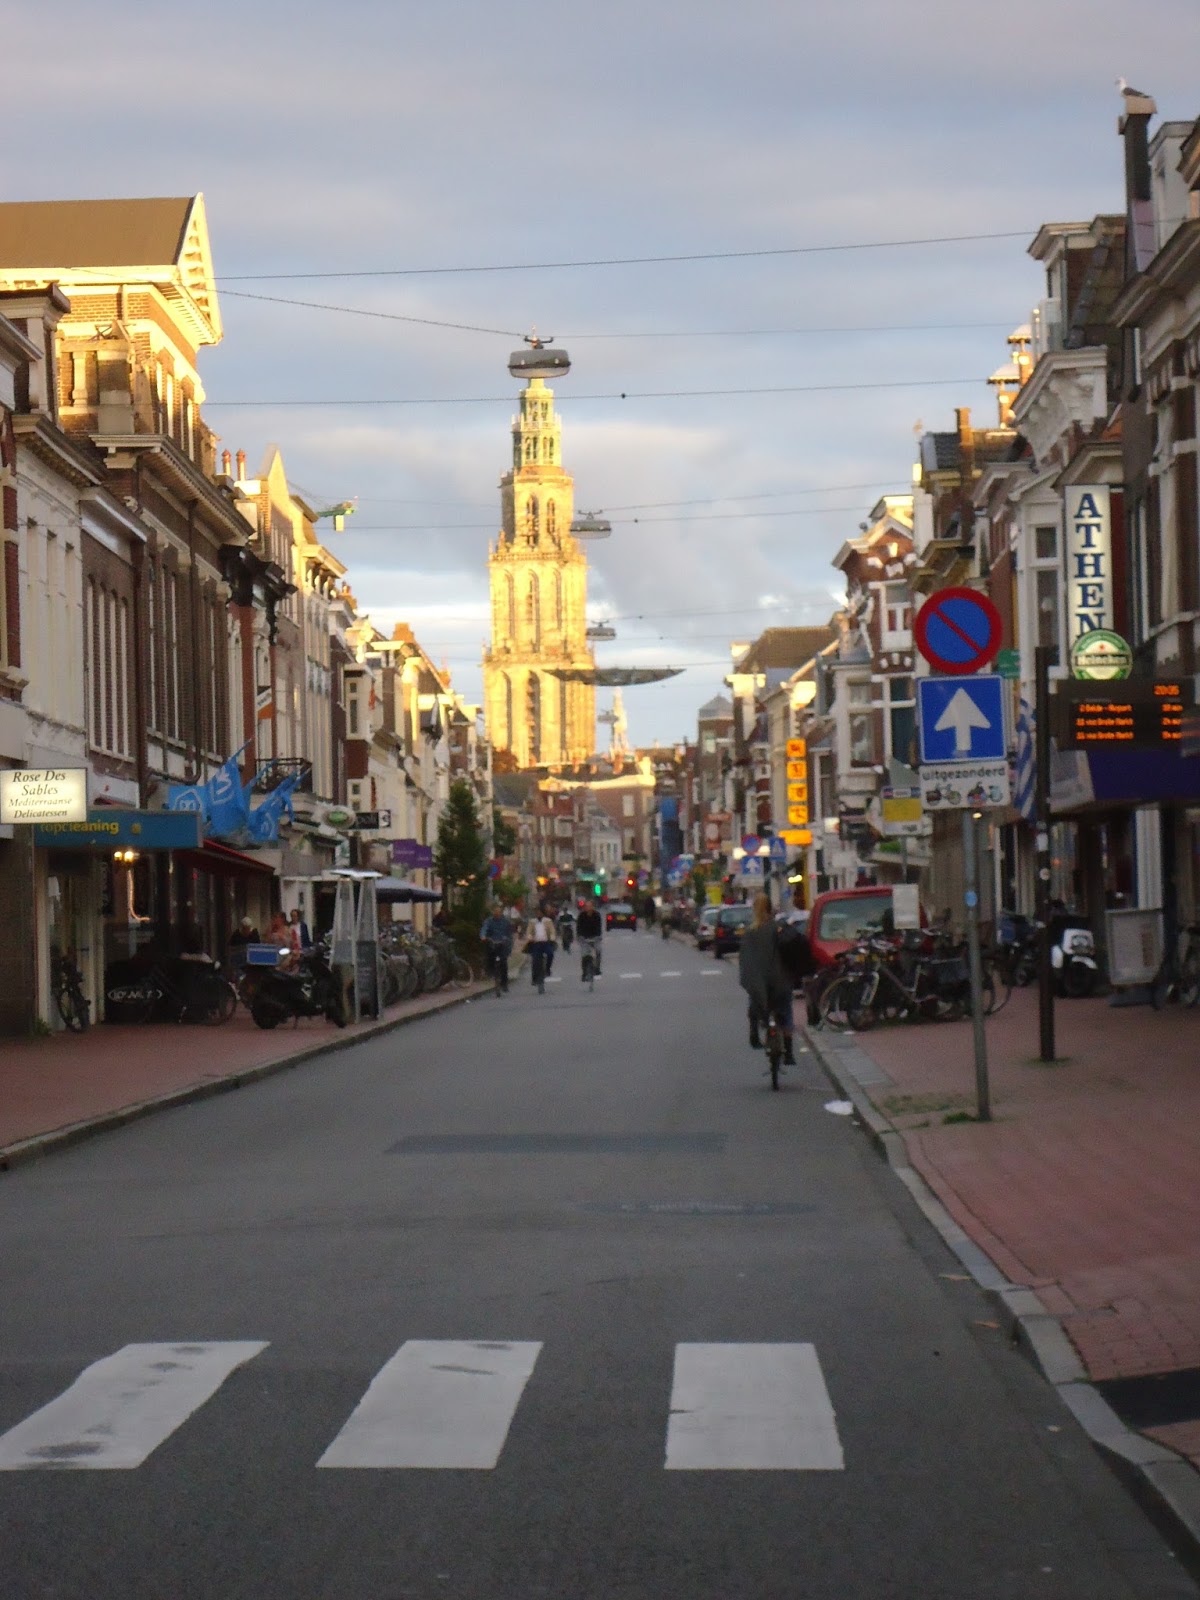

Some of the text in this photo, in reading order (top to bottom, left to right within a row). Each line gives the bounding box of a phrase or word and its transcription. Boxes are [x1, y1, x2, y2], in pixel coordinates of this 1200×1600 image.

[13, 770, 66, 783] Rose Des
[922, 766, 1006, 782] uitgezonderd
[21, 784, 59, 796] Sables
[14, 809, 68, 819] Delicatessen
